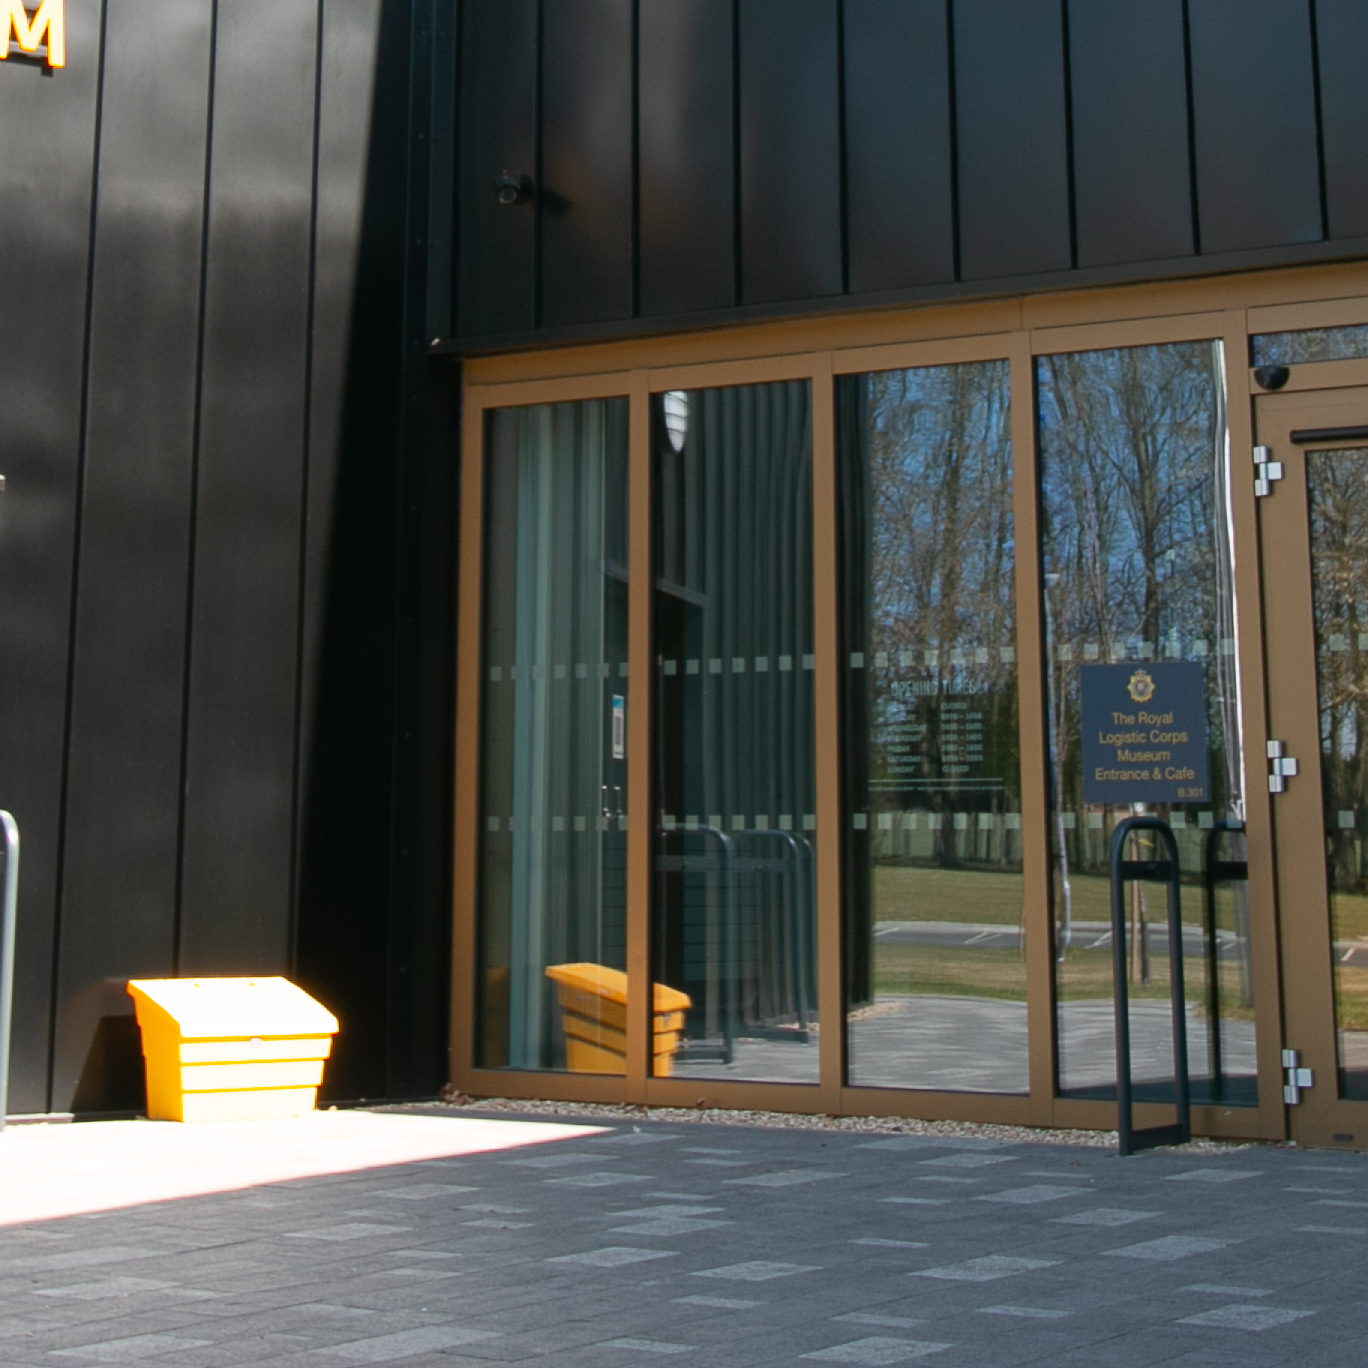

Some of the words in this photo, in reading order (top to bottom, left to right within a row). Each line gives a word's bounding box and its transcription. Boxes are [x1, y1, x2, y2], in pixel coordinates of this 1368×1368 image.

[1112, 712, 1135, 725] The
[1138, 711, 1174, 727] Royal
[1098, 730, 1147, 746] Logistic
[1150, 729, 1188, 745] Corps
[1117, 749, 1171, 762] Museum
[1095, 767, 1150, 781] Entrance
[1153, 767, 1162, 780] &
[1165, 766, 1195, 780] Cafe
